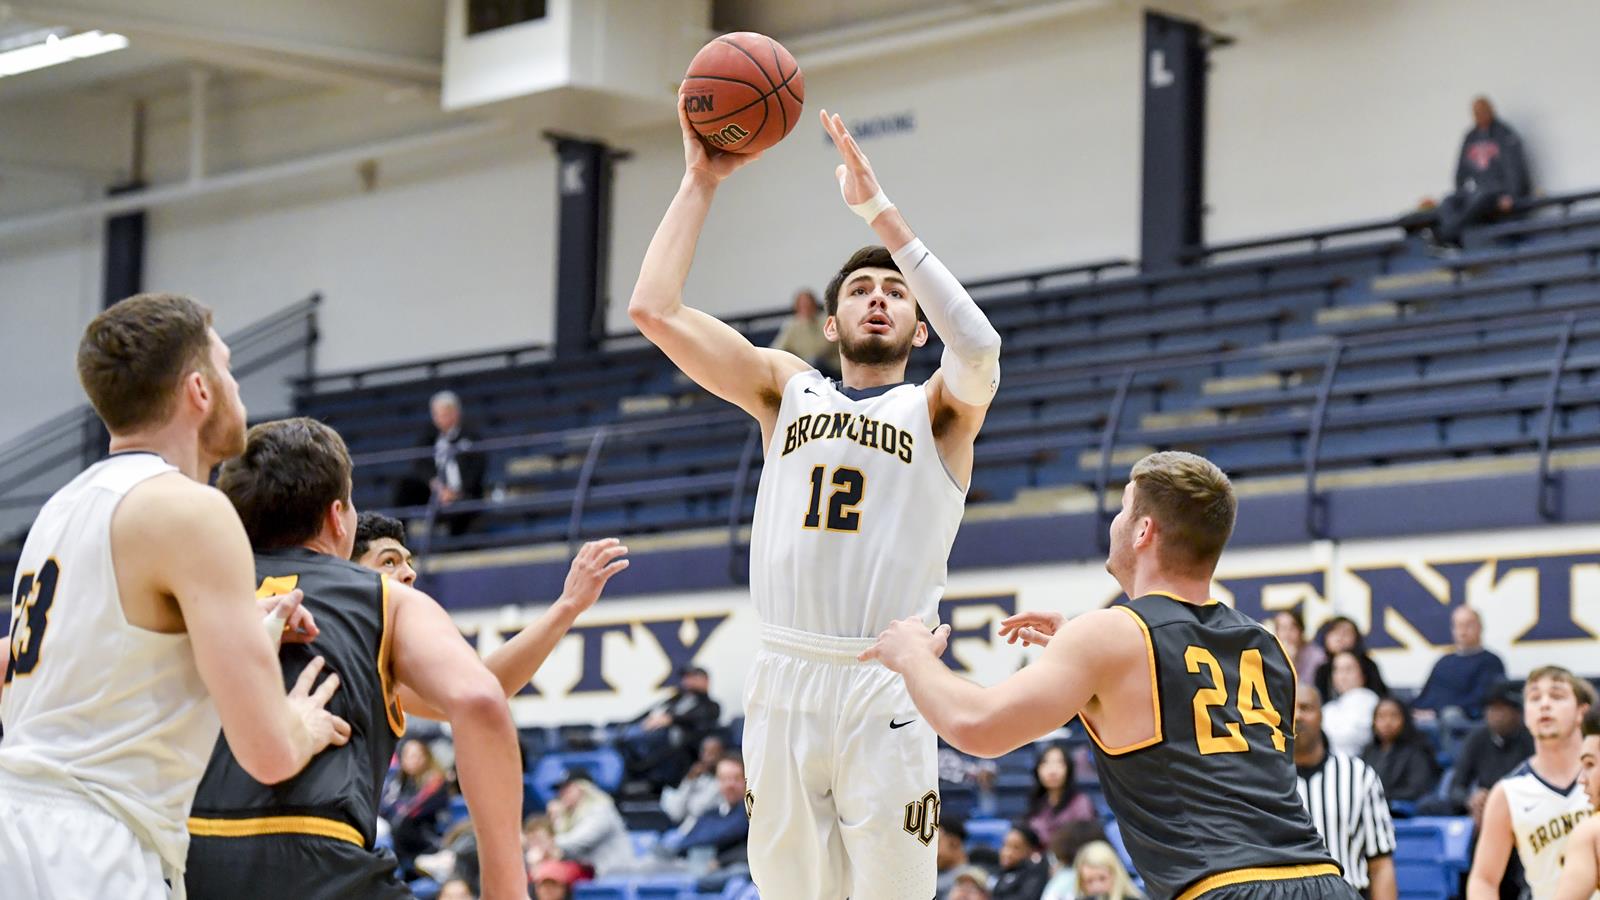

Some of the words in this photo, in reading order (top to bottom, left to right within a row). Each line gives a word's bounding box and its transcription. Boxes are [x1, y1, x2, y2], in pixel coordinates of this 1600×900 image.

[1151, 50, 1175, 87] L
[685, 94, 714, 113] NCA
[781, 413, 914, 464] BRONCHOS
[802, 463, 867, 534] 12
[1104, 548, 1600, 652] ENT
[1184, 645, 1286, 755] 24
